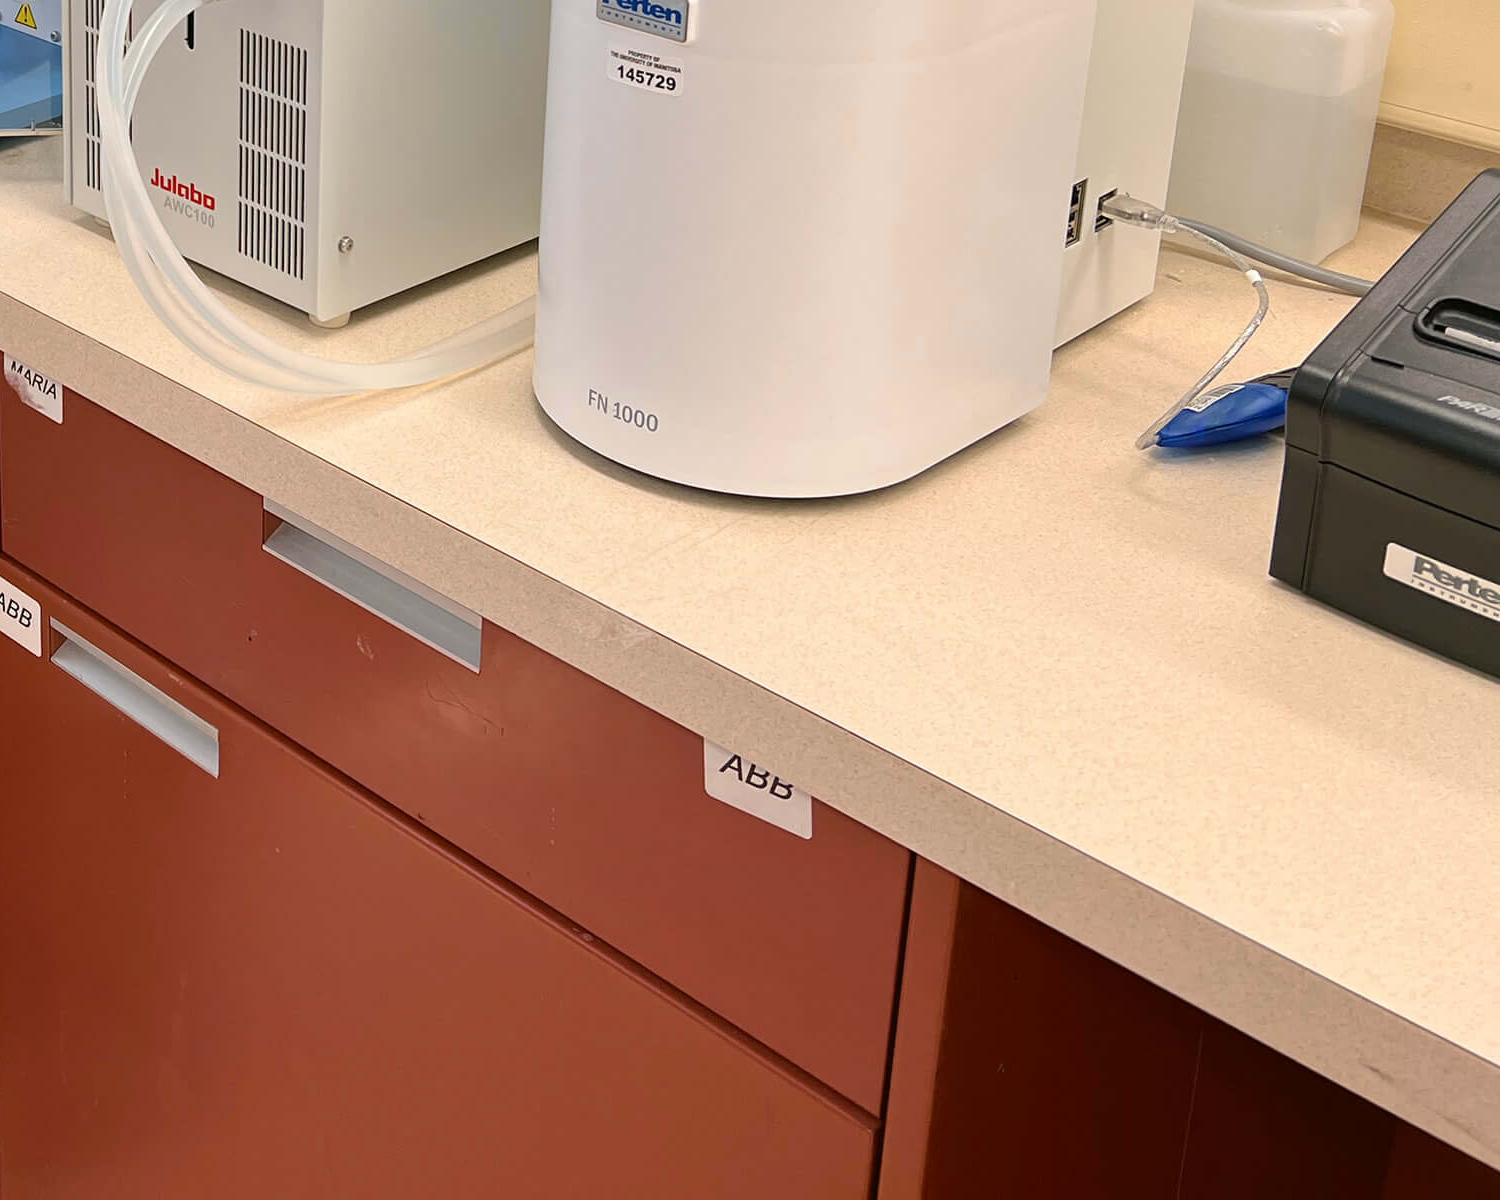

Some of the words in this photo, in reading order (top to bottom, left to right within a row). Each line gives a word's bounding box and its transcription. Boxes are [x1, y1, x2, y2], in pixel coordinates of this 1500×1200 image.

[617, 65, 677, 91] 145729
[150, 167, 216, 211] Julabo
[163, 196, 216, 228] AWC100
[588, 388, 608, 414] FN
[613, 401, 659, 432] 1000
